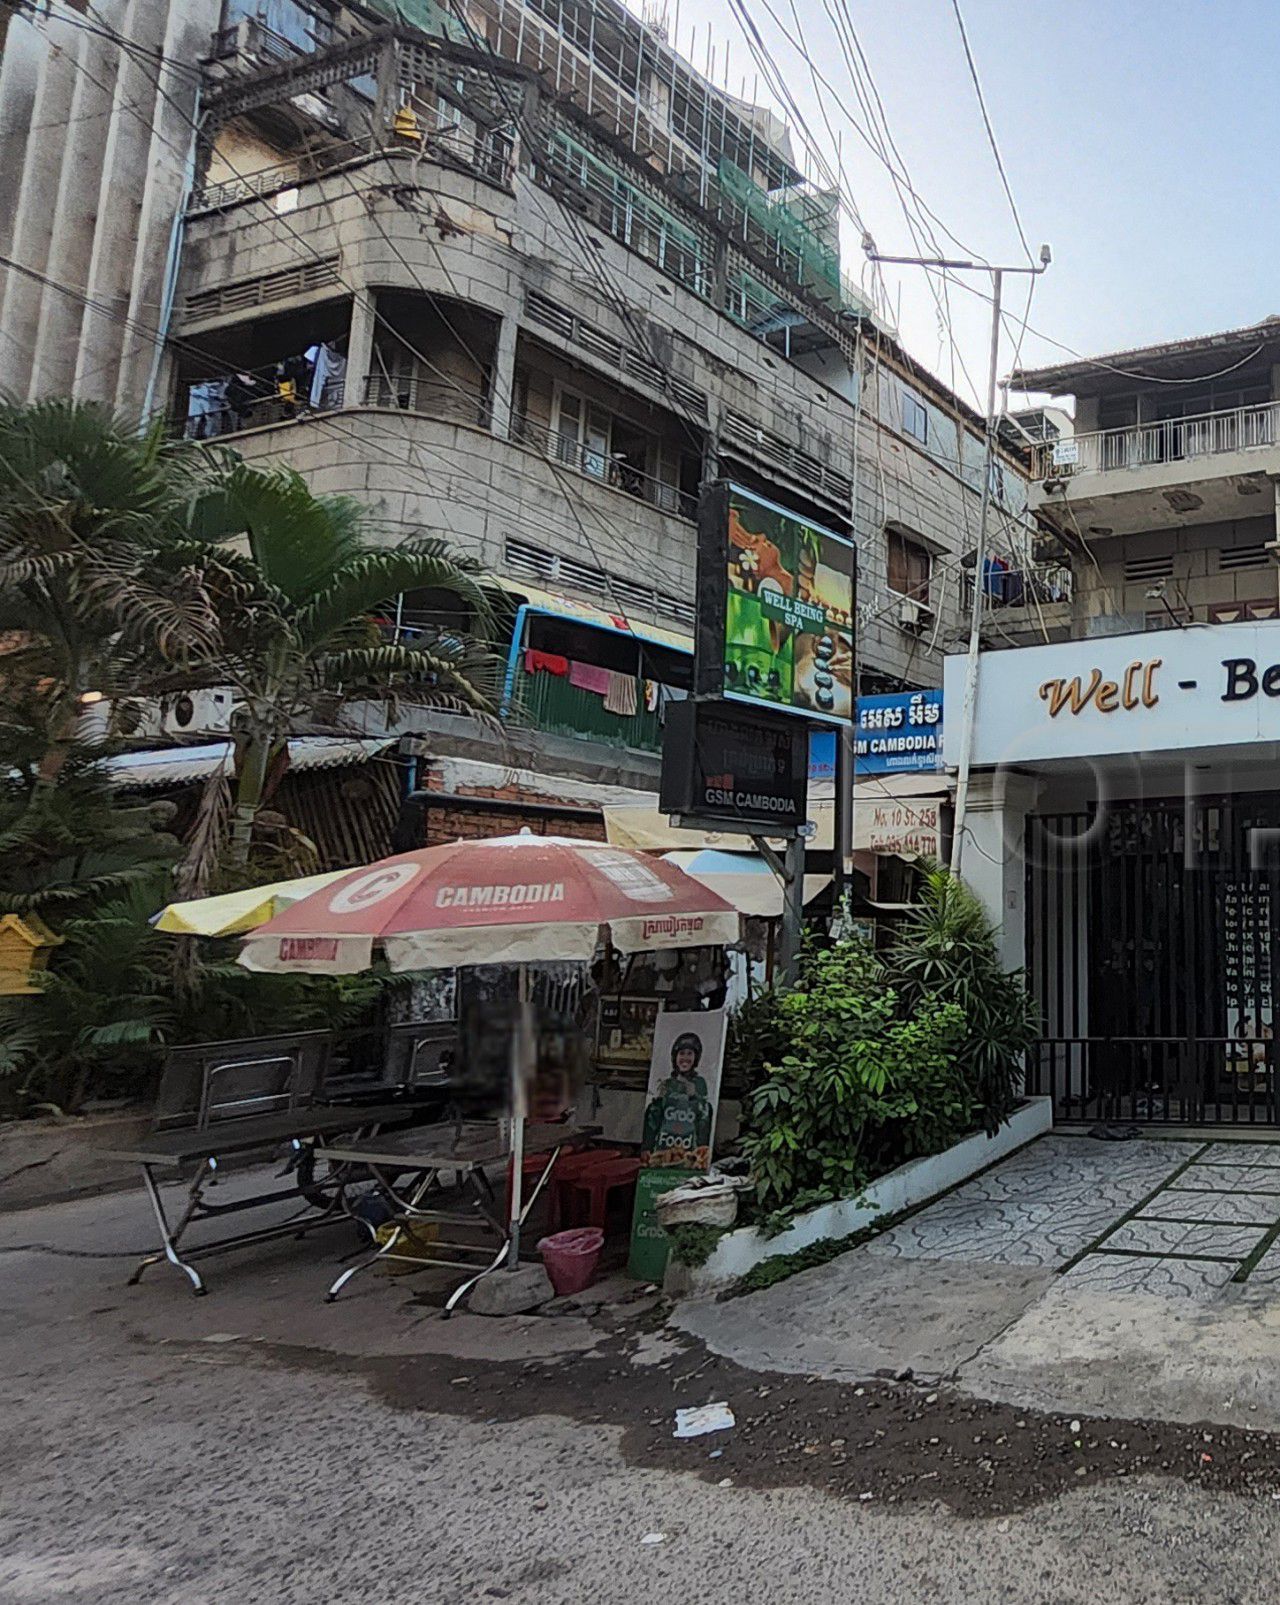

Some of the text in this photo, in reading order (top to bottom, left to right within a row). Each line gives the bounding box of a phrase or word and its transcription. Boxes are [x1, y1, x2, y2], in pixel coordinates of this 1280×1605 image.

[763, 590, 824, 623] WELL BEING
[784, 612, 804, 629] SPA
[1038, 657, 1163, 718] Well
[870, 735, 937, 753] CAMBODIA
[705, 788, 796, 813] GSM CAMBODIA
[434, 882, 565, 909] CAMBODIA
[663, 1106, 696, 1123] Grab
[659, 1132, 693, 1149] Food
